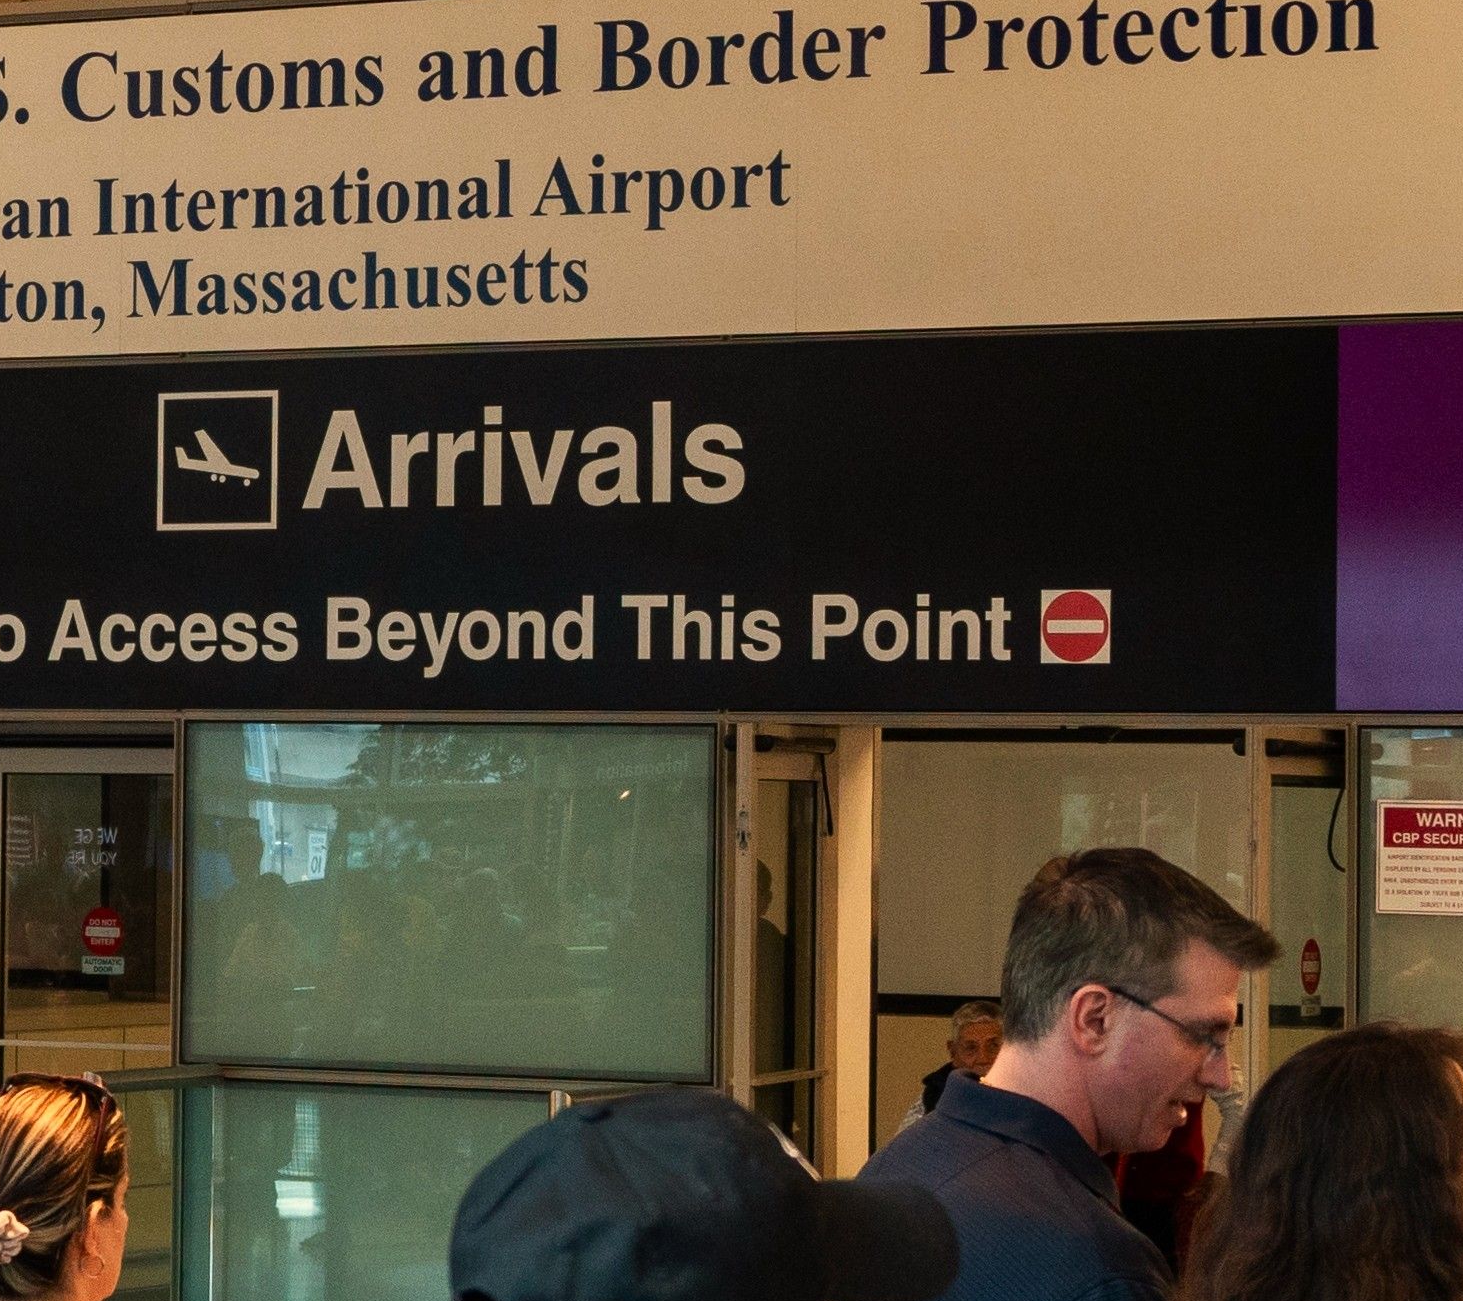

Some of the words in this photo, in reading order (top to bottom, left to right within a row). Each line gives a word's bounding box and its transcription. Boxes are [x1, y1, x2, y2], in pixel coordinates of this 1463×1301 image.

[60, 49, 384, 124] Customs
[415, 24, 561, 101] and
[593, 9, 887, 95] Border
[91, 159, 513, 239] International
[530, 149, 793, 232] Airport
[126, 248, 589, 322] Massachusetts
[302, 400, 747, 510] Arrivals
[48, 599, 298, 663] Access
[324, 595, 595, 678] Beyond
[622, 594, 782, 662] This
[811, 592, 1012, 663] Point
[1392, 833, 1419, 844] CBP
[89, 918, 100, 926] DO
[90, 938, 115, 946] ENTER
[84, 958, 122, 966] AUTOMATIC
